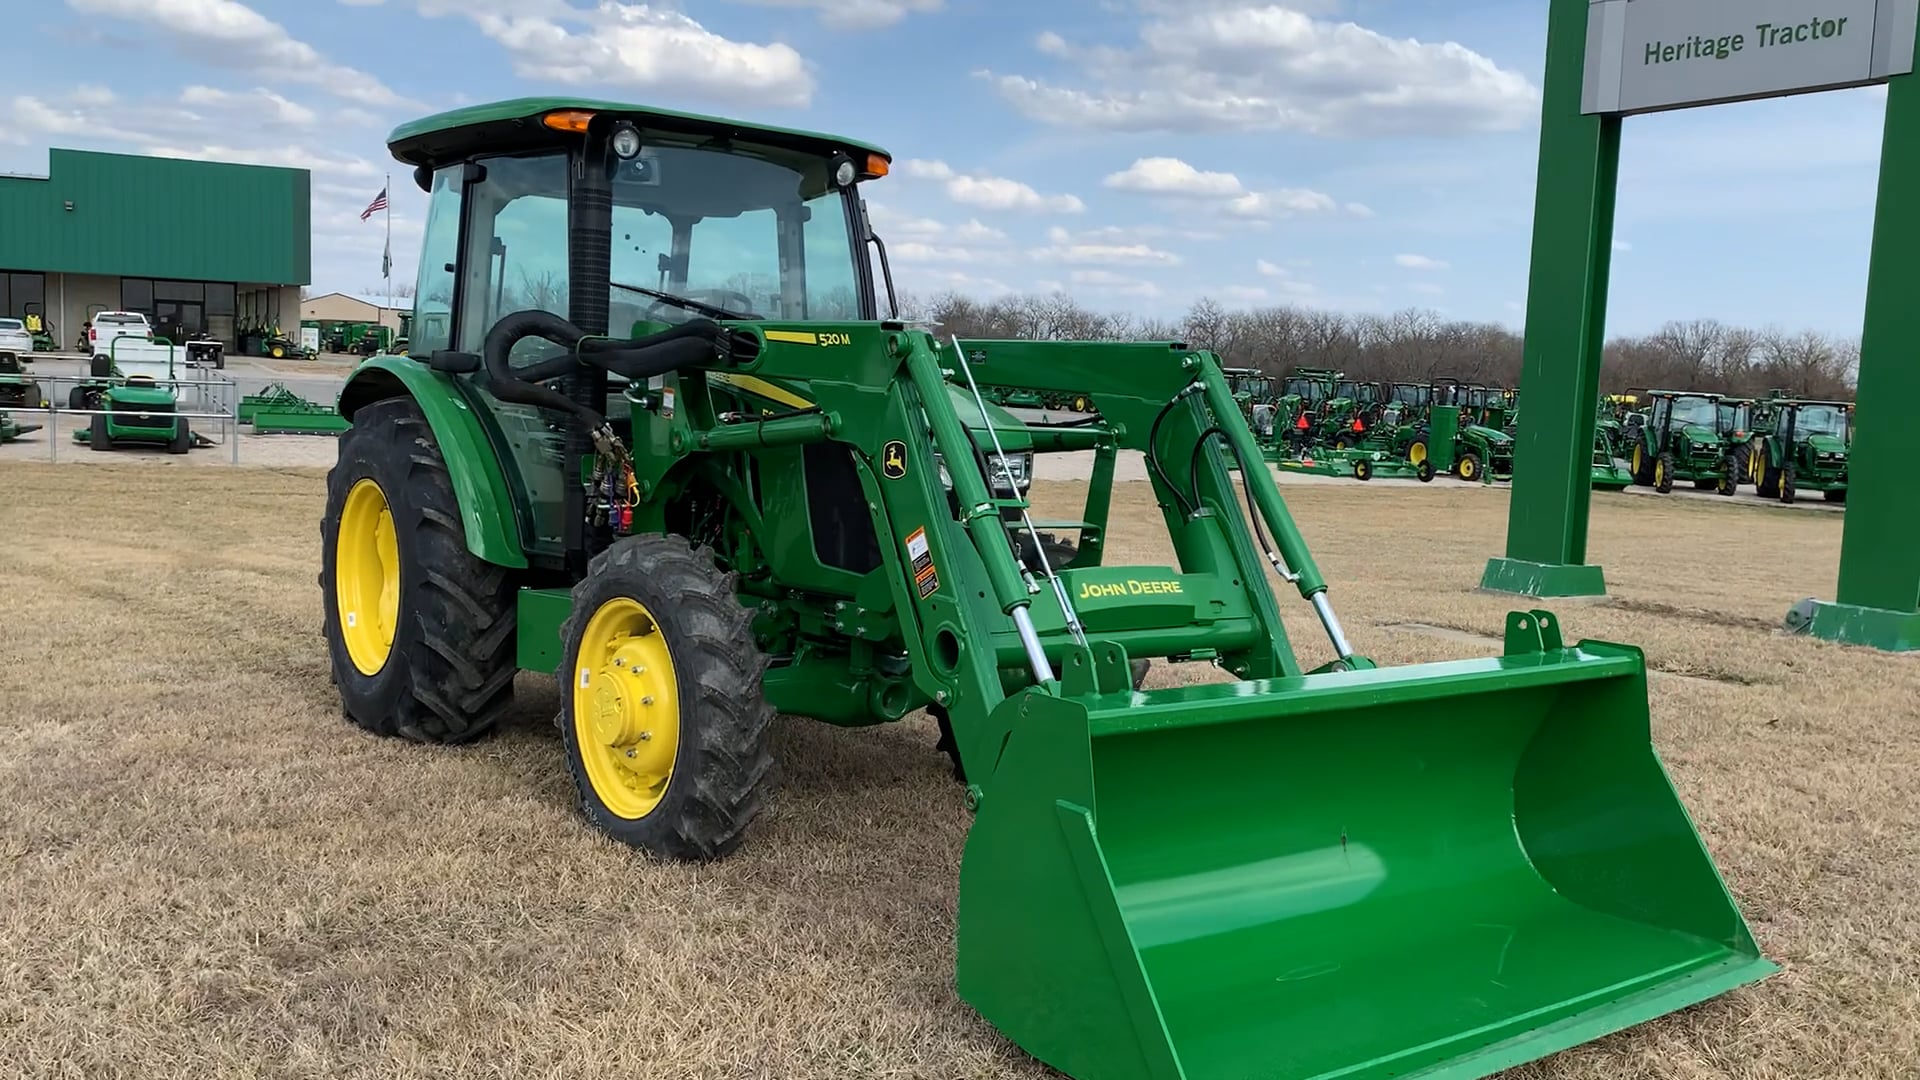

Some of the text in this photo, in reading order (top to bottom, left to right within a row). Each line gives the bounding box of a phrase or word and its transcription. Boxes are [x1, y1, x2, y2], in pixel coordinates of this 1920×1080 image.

[1644, 17, 1848, 65] Heritage Tractor
[1080, 580, 1183, 599] JOHN DEERE
